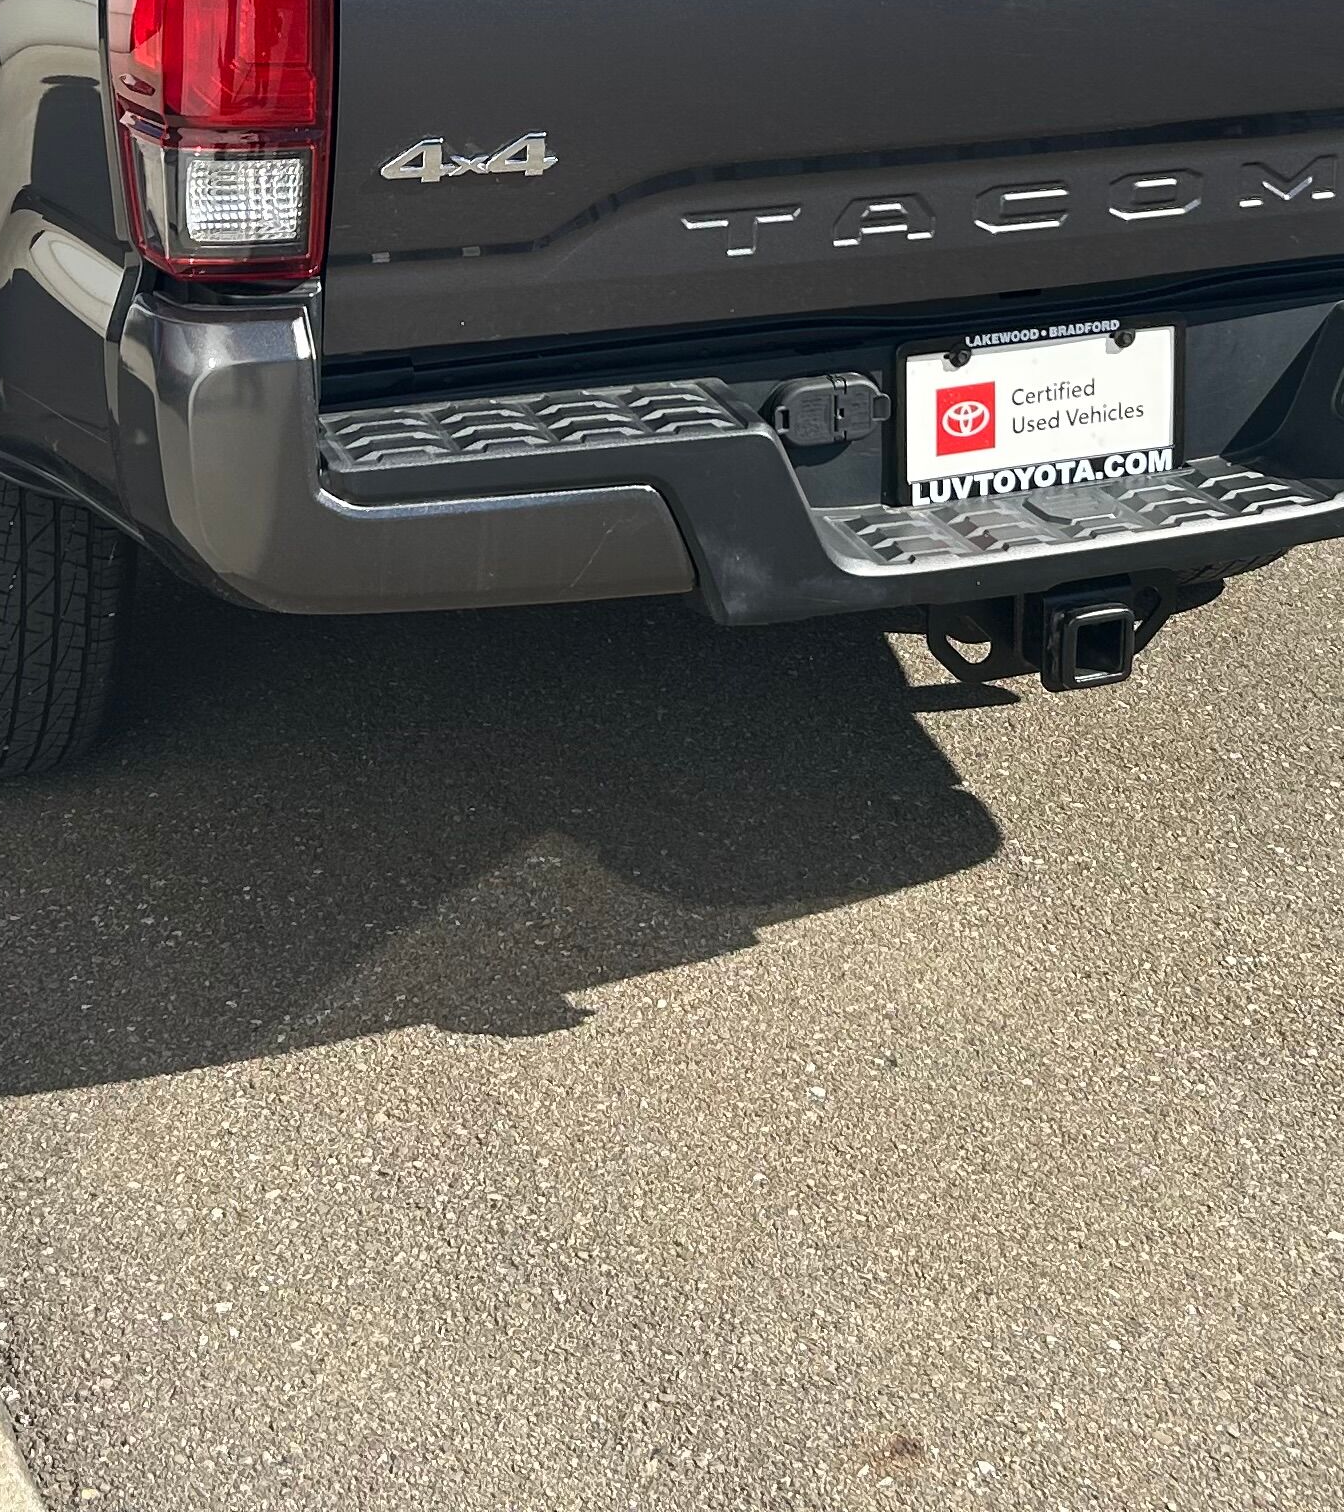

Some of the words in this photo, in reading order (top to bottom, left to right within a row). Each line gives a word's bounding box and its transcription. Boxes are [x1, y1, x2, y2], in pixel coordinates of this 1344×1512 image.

[380, 131, 559, 183] 4x4
[965, 328, 1040, 348] LAKEWOOD
[1048, 318, 1120, 339] BRADFORD
[1011, 377, 1096, 406] Certified
[1012, 409, 1060, 434] Used
[1066, 402, 1145, 429] Vehicles
[911, 448, 1174, 507] LUVTOYOTA.COM
